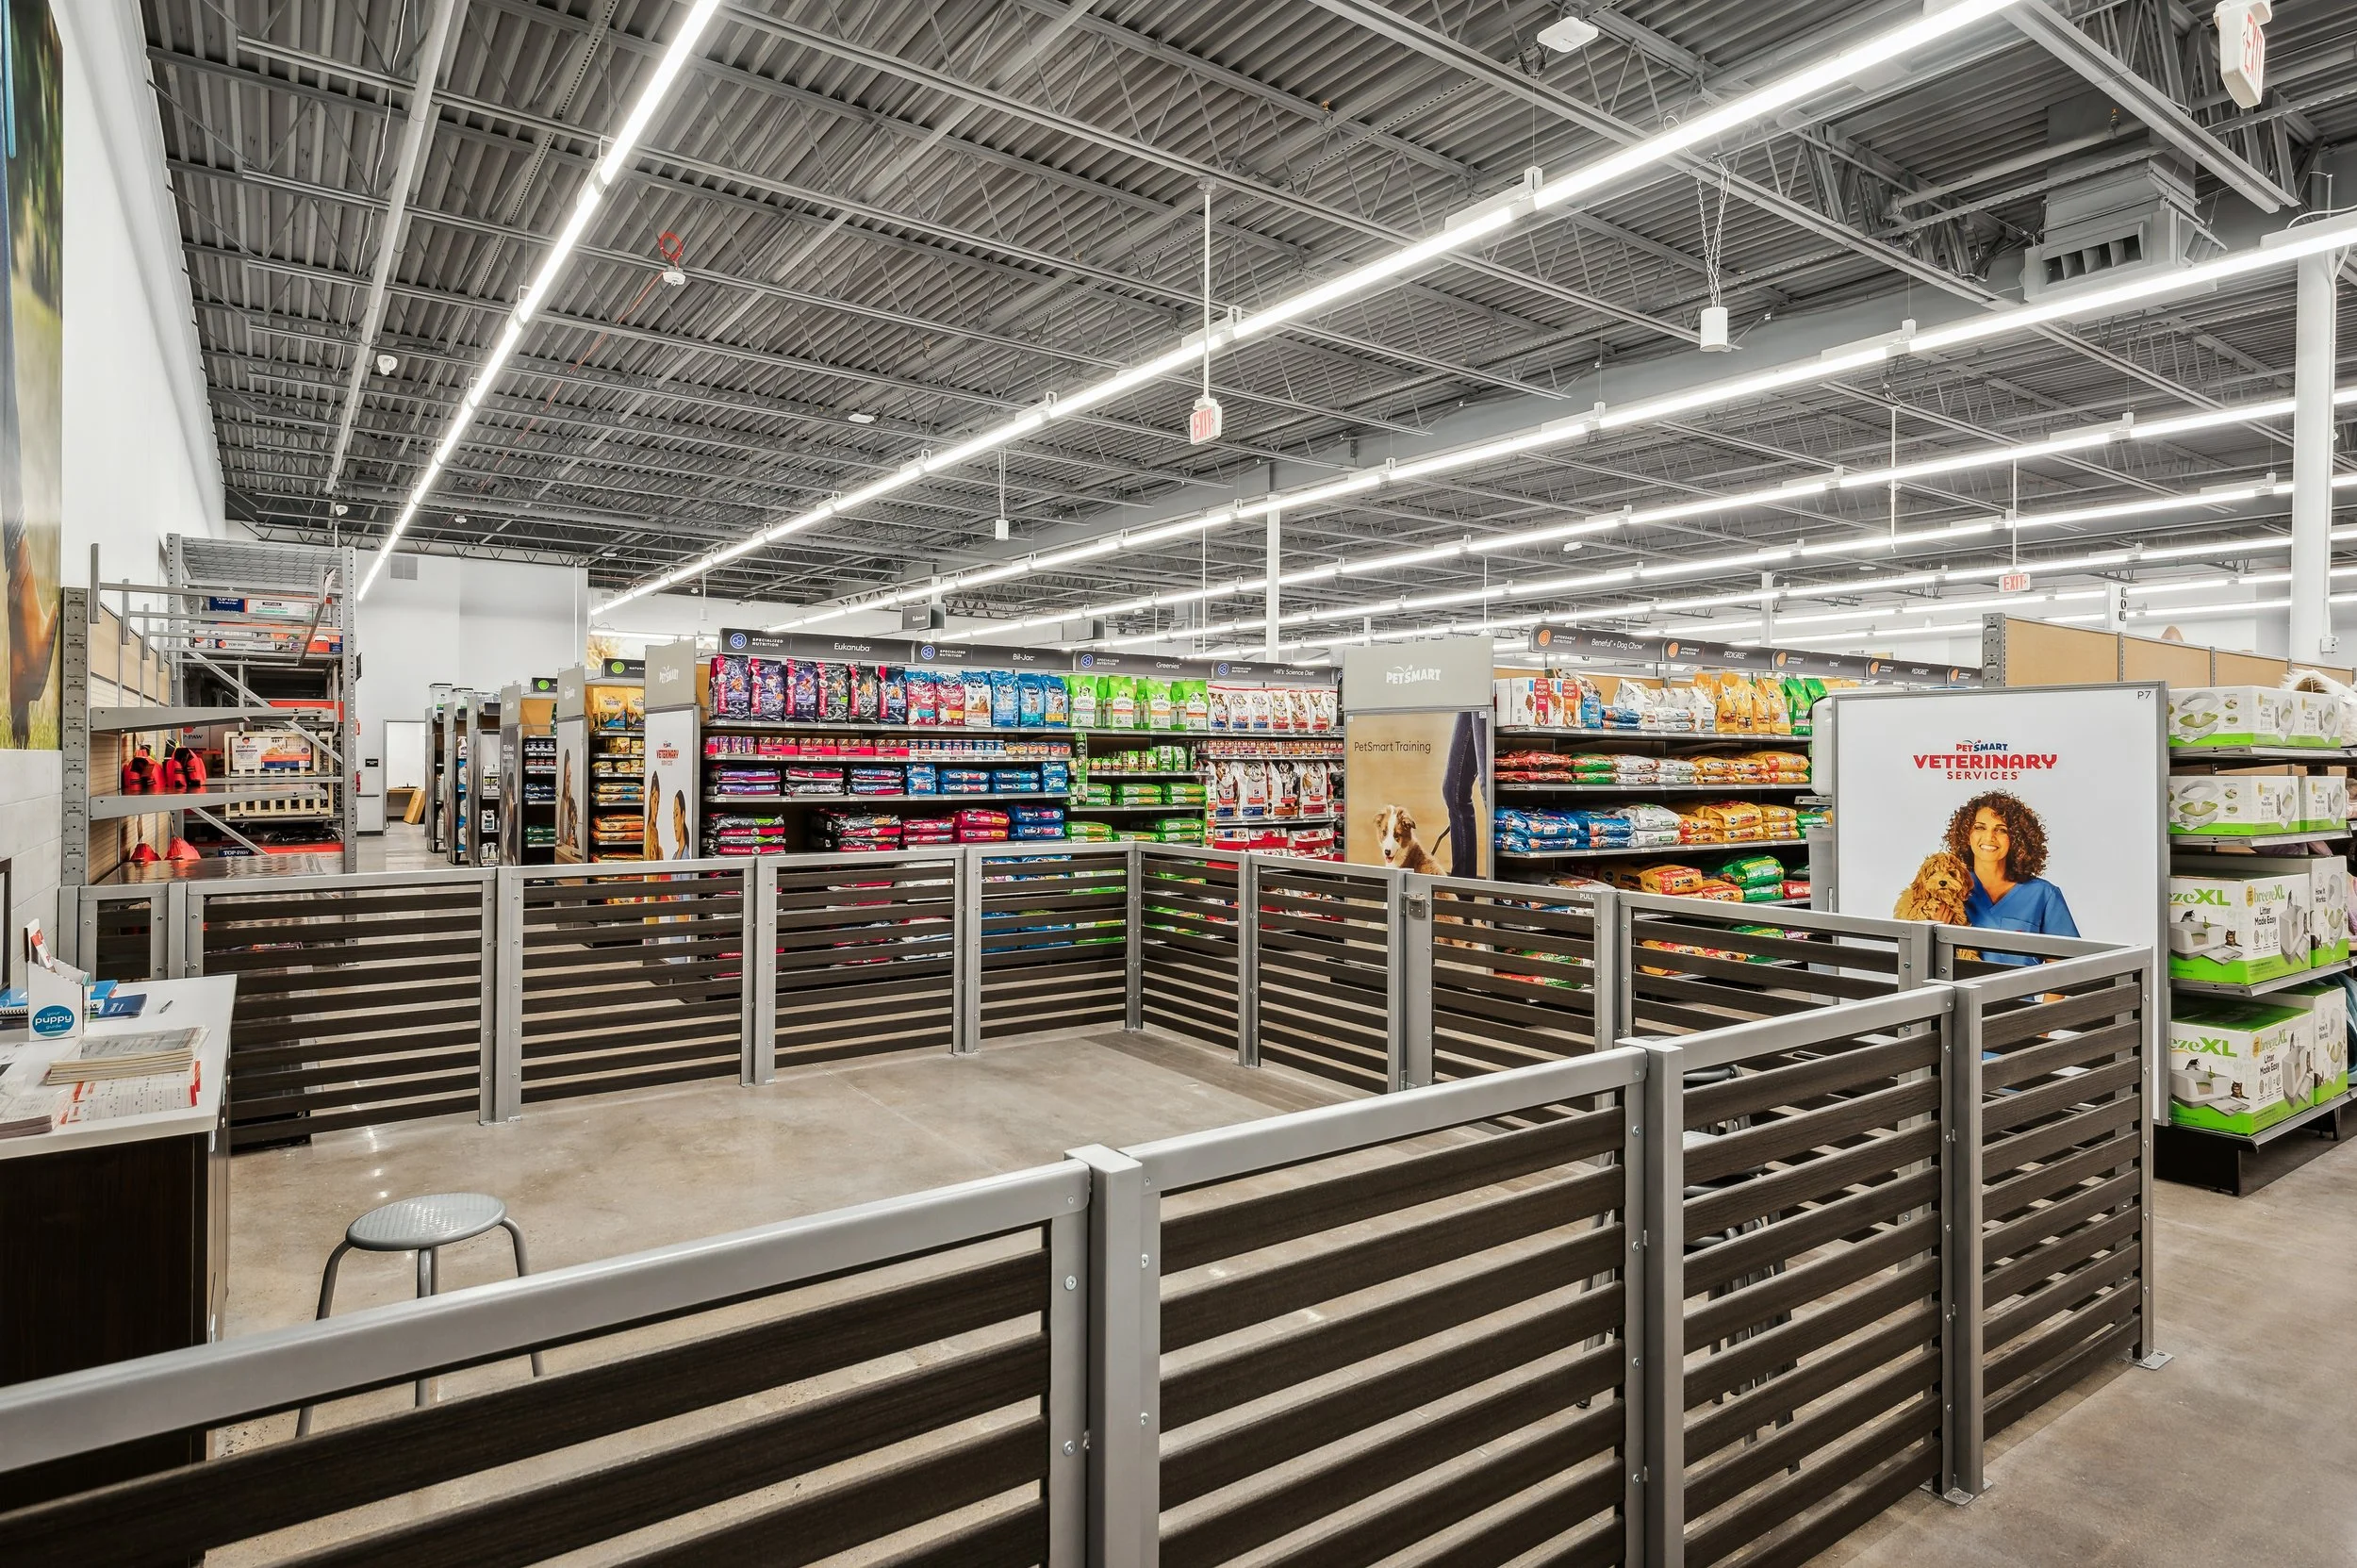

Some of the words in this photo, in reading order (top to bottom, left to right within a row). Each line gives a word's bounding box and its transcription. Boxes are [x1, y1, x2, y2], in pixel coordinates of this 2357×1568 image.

[1193, 407, 1212, 441] EXIT
[2003, 574, 2025, 591] EXIT
[833, 642, 870, 652] Eukanuba
[1591, 637, 1612, 648] Beneful
[1616, 641, 1628, 651] Dog
[1628, 642, 1643, 651] Chow
[1723, 651, 1746, 660] PEDIGREE
[1386, 666, 1442, 685] PETSMART
[2137, 690, 2151, 700] P7
[1354, 741, 1393, 752] PetSmart
[1395, 741, 1431, 754] Training
[1956, 742, 2009, 751] PETSMART
[1913, 754, 2058, 769] VETERINARY
[1947, 770, 2018, 781] SERVICES
[2254, 883, 2285, 904] breezeXL
[2259, 906, 2271, 916] Litter
[2254, 916, 2266, 926] Made
[2266, 916, 2277, 926] Easy
[35, 1014, 73, 1026] puppy
[2264, 1053, 2275, 1065] Litter
[2260, 1065, 2271, 1076] Made
[2271, 1063, 2280, 1074] Easy
